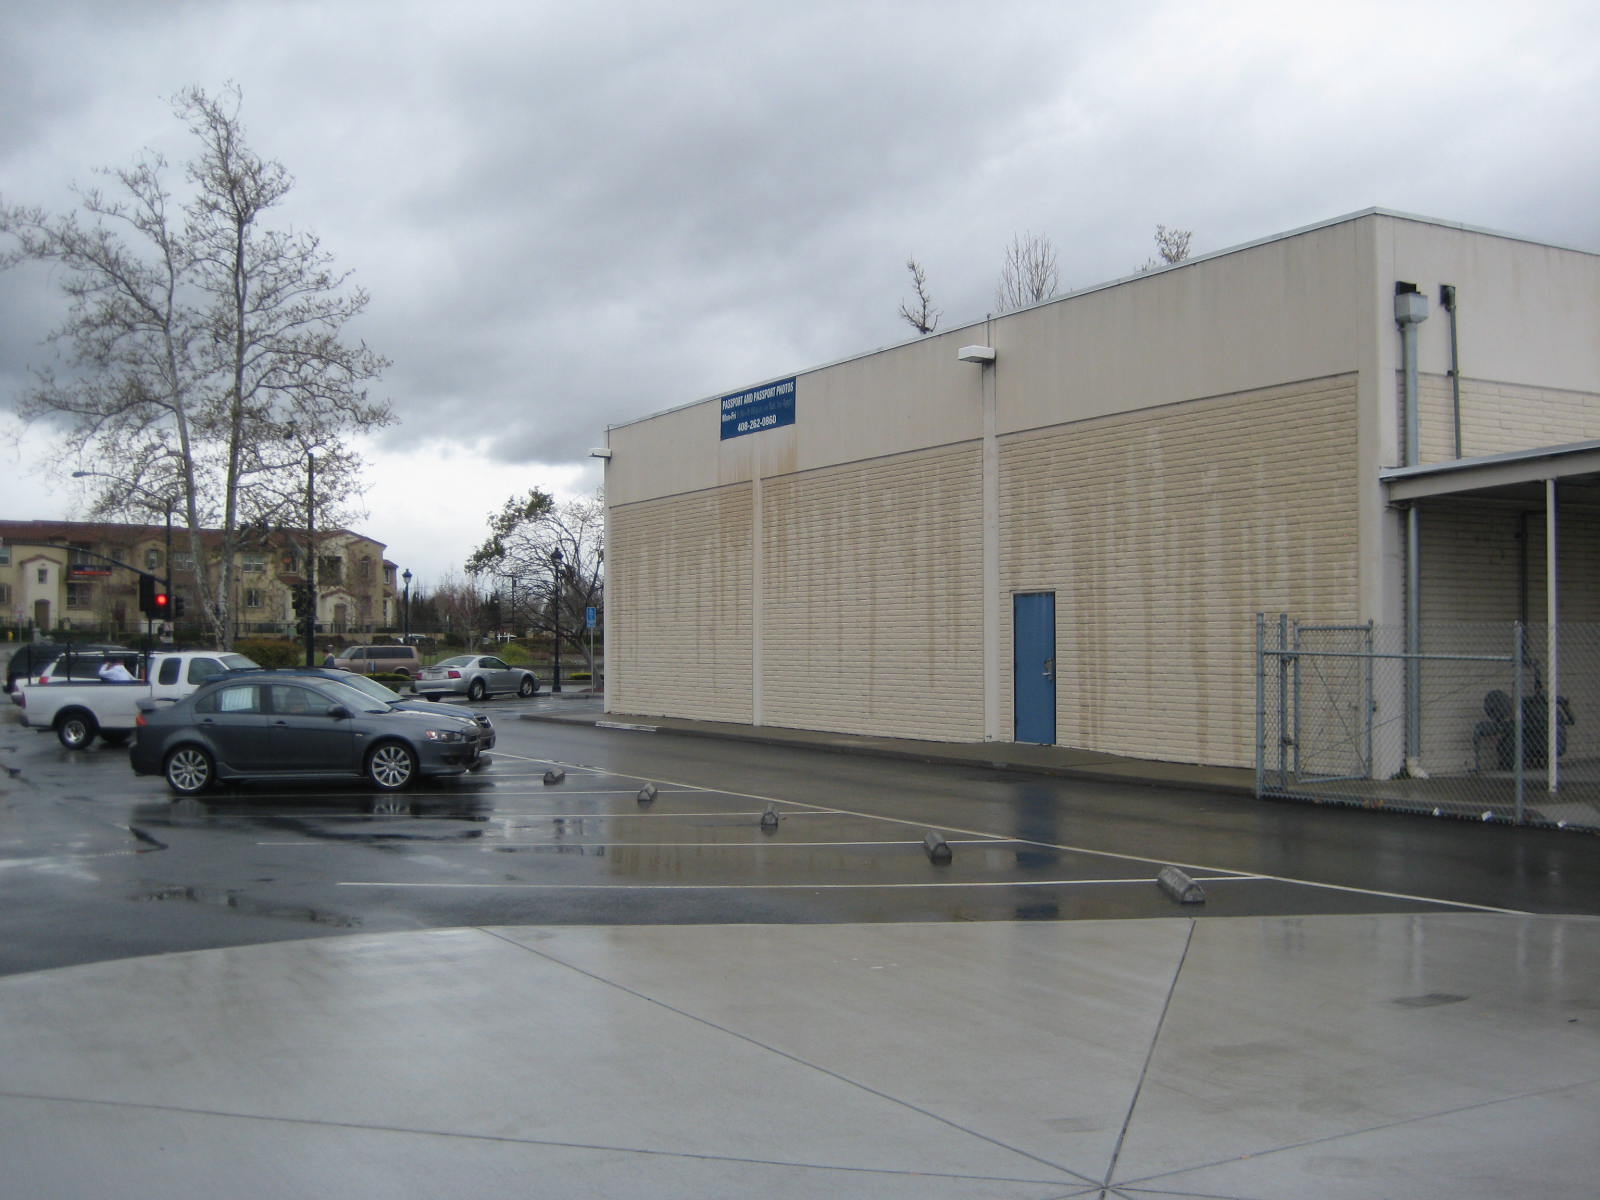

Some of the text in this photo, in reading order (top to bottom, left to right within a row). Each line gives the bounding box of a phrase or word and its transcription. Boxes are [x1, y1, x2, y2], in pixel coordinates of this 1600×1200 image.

[722, 396, 743, 410] PASSPORT
[744, 393, 753, 405] AND
[753, 387, 776, 402] PASSPORT
[776, 382, 794, 396] PHOTOS
